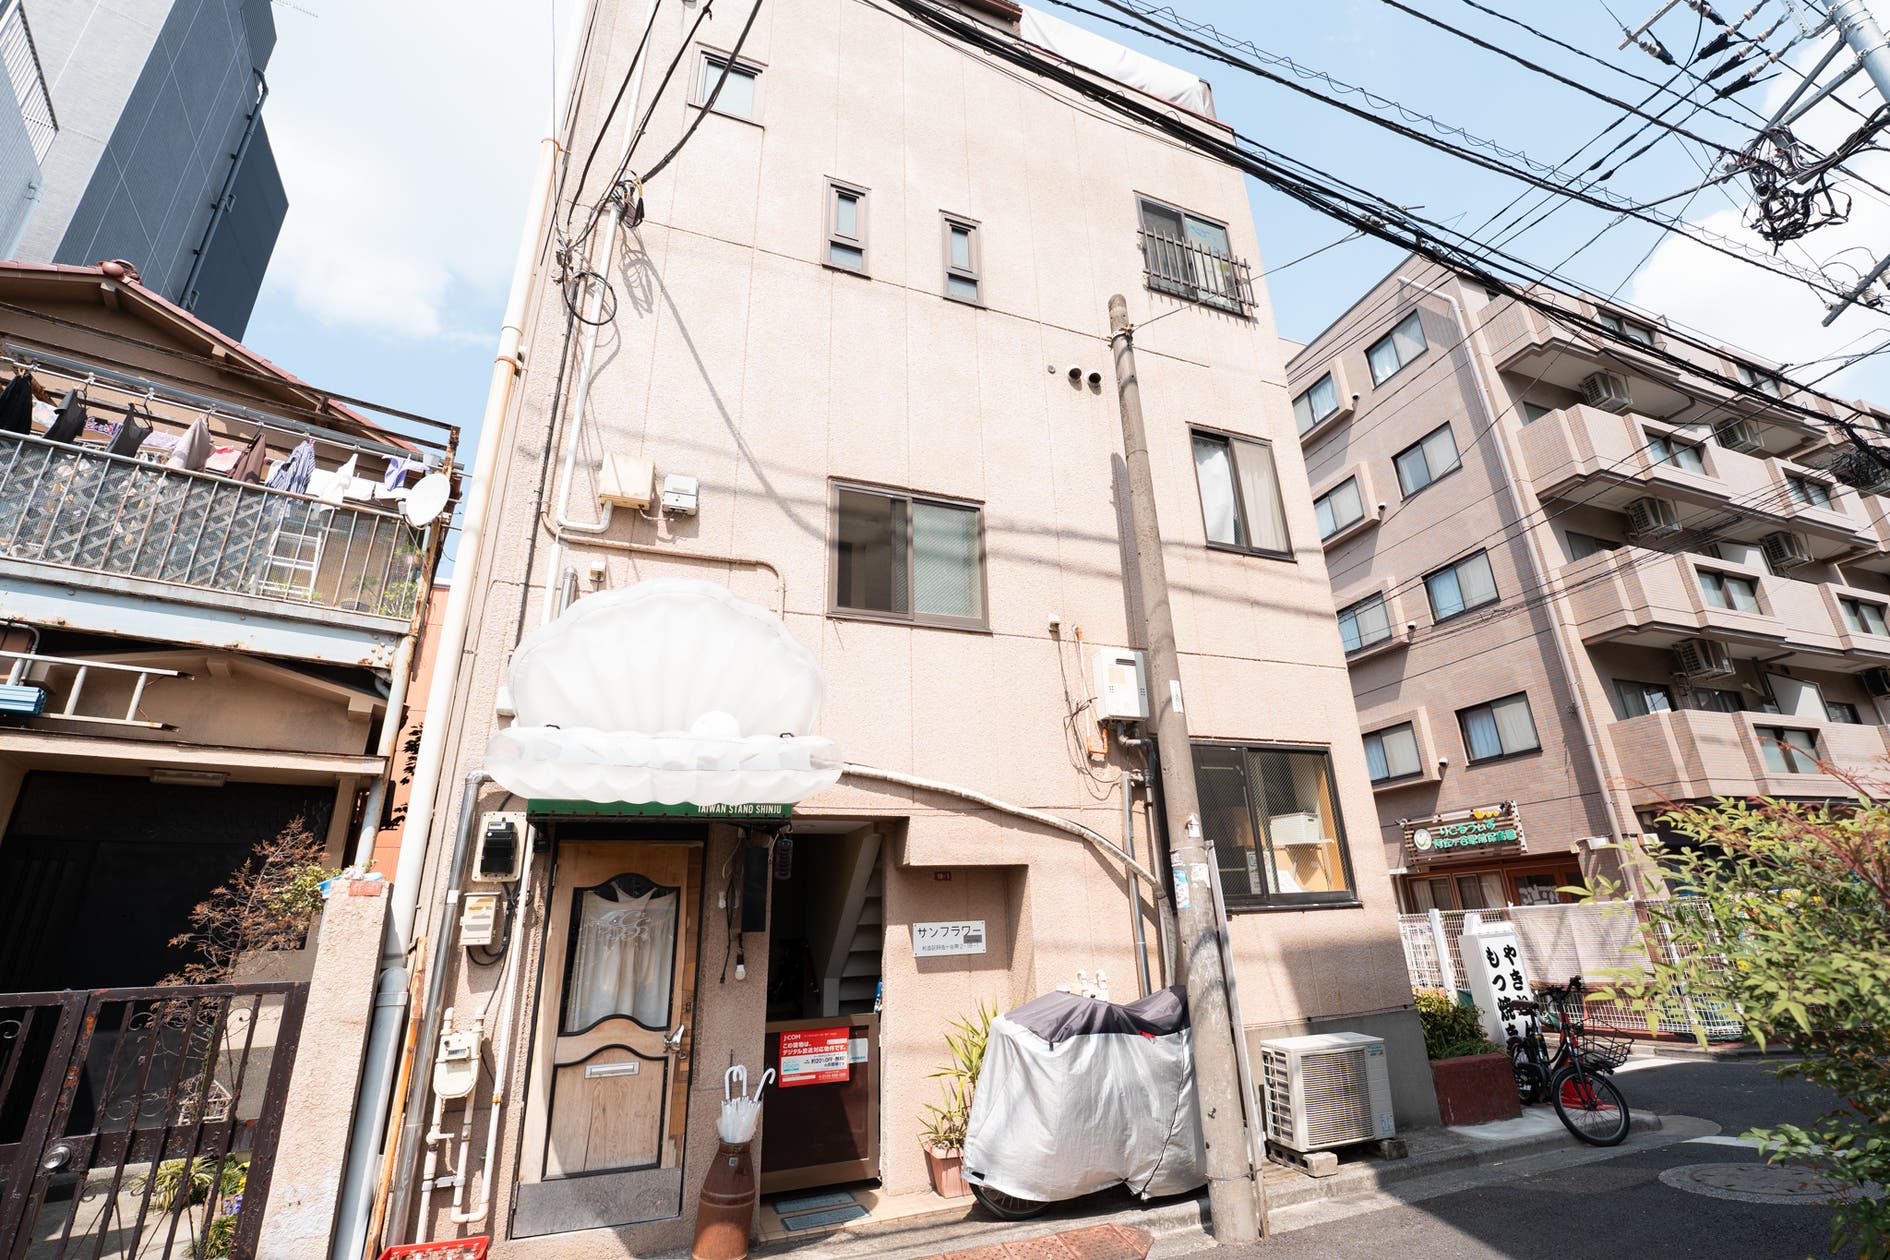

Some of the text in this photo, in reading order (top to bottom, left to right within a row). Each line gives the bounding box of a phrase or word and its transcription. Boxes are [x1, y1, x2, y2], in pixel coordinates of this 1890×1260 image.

[698, 804, 782, 814] TAIWAN STAND SHINJU
[918, 926, 981, 938] サンフラワー
